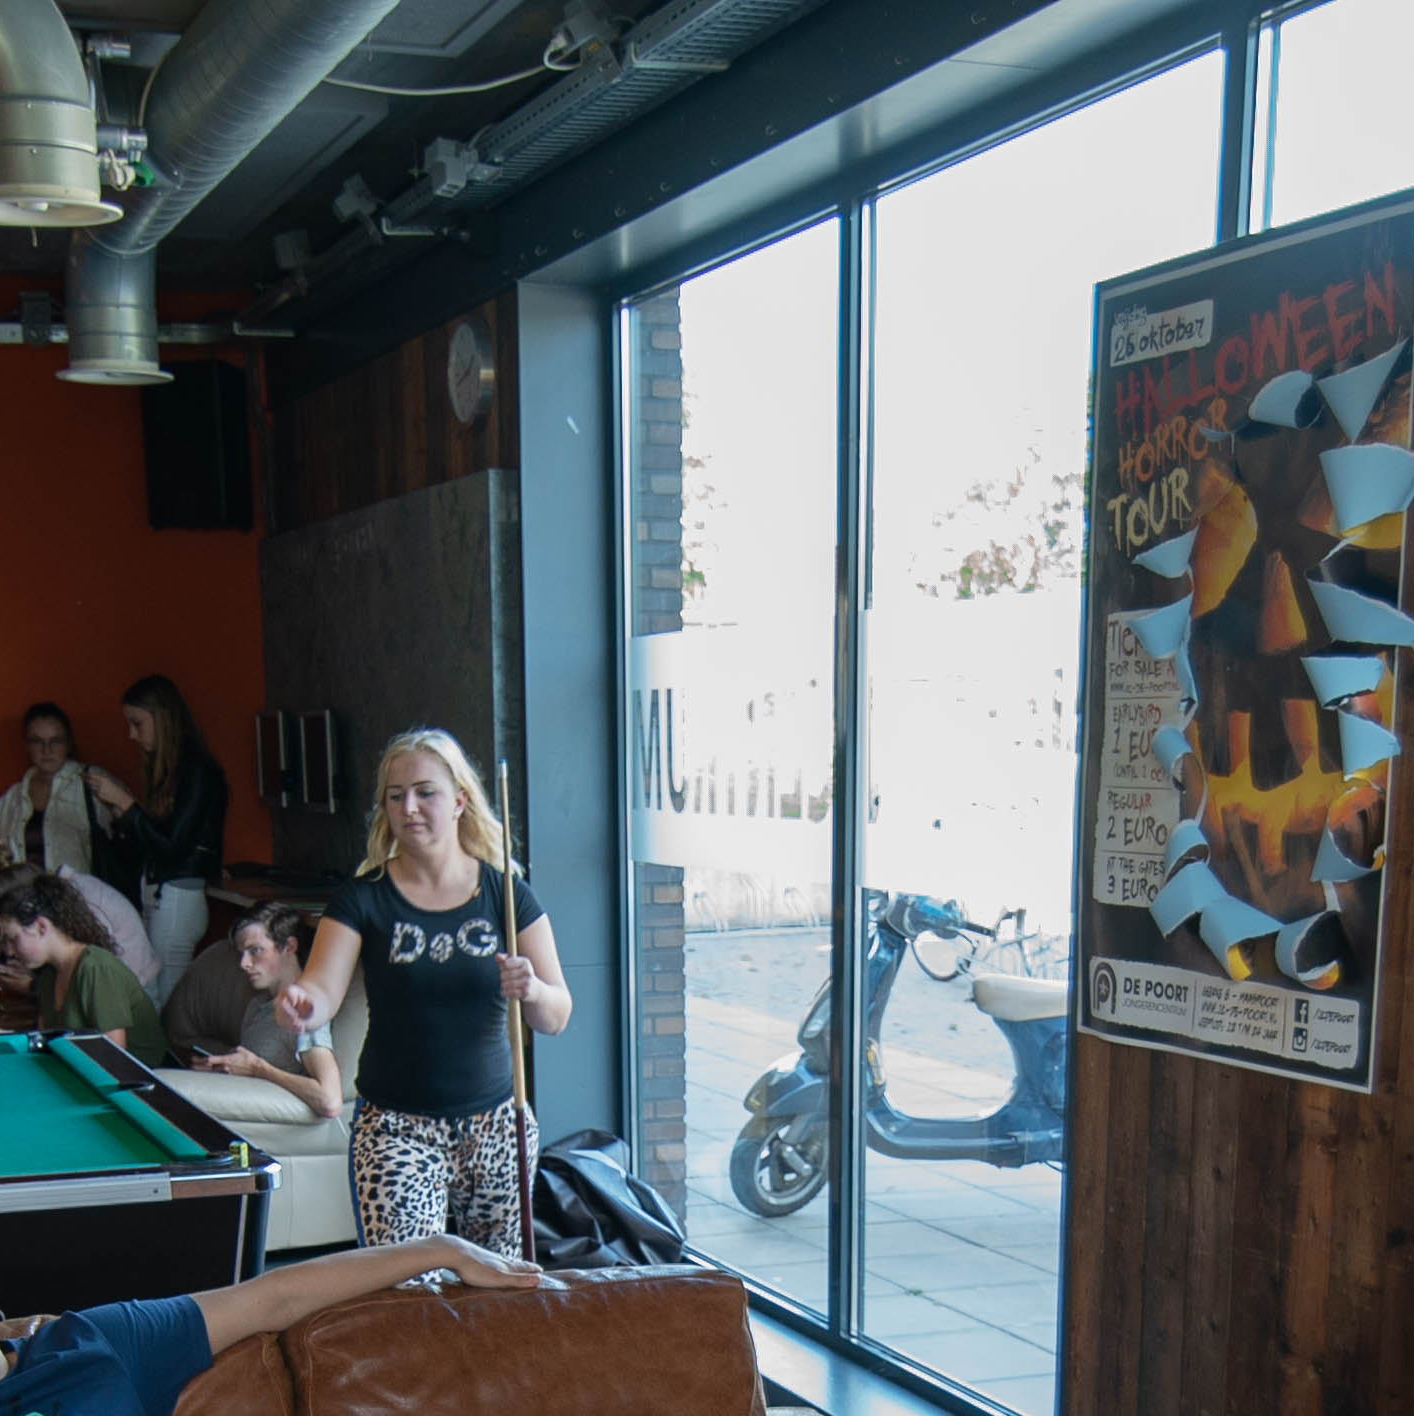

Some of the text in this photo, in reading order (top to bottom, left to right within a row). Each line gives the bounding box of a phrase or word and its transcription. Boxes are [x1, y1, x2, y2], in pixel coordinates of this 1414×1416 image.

[1114, 316, 1205, 363] 26 oktober
[1115, 263, 1395, 437] HALLOWEEN
[1107, 467, 1193, 556] TOUR
[1109, 660, 1129, 677] FOR
[1134, 660, 1162, 682] SALE
[1112, 727, 1121, 754] 1
[1107, 789, 1152, 814] REGULAR
[1106, 815, 1168, 846] 2 EURO
[1118, 857, 1134, 875] THE
[1138, 860, 1165, 878] GATES
[1107, 875, 1159, 903] 3 EURO
[1123, 977, 1140, 995] DE
[1144, 980, 1189, 1003] POORT
